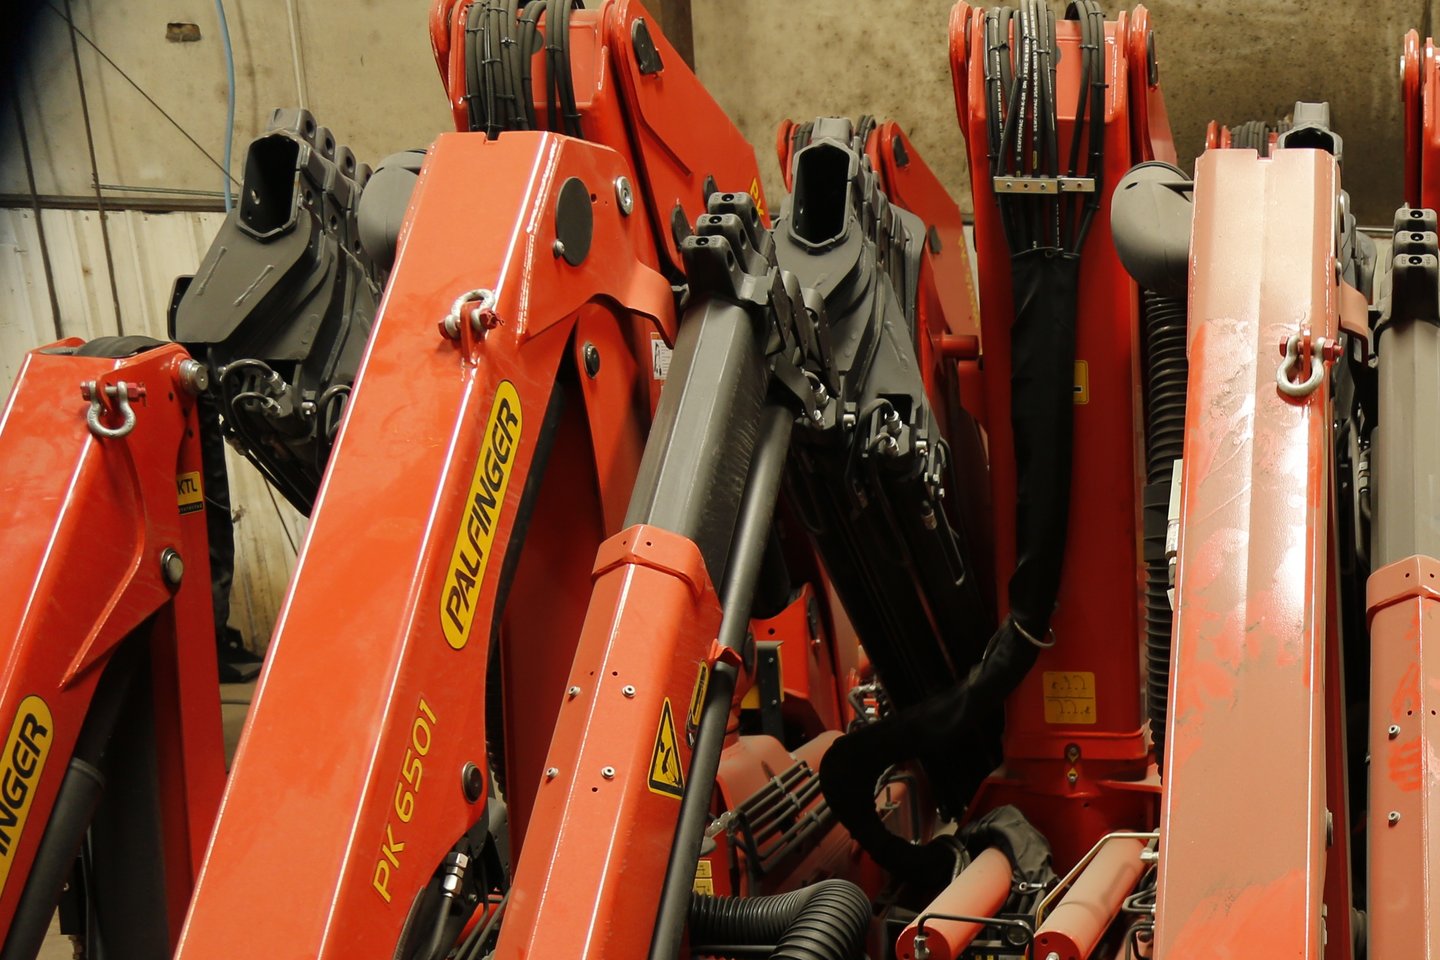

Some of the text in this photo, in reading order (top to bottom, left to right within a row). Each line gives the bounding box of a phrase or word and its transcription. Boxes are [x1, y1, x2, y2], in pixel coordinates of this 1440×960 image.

[177, 478, 198, 495] KTL
[446, 397, 519, 635] PALFINGER
[372, 698, 437, 903] PK 6501
